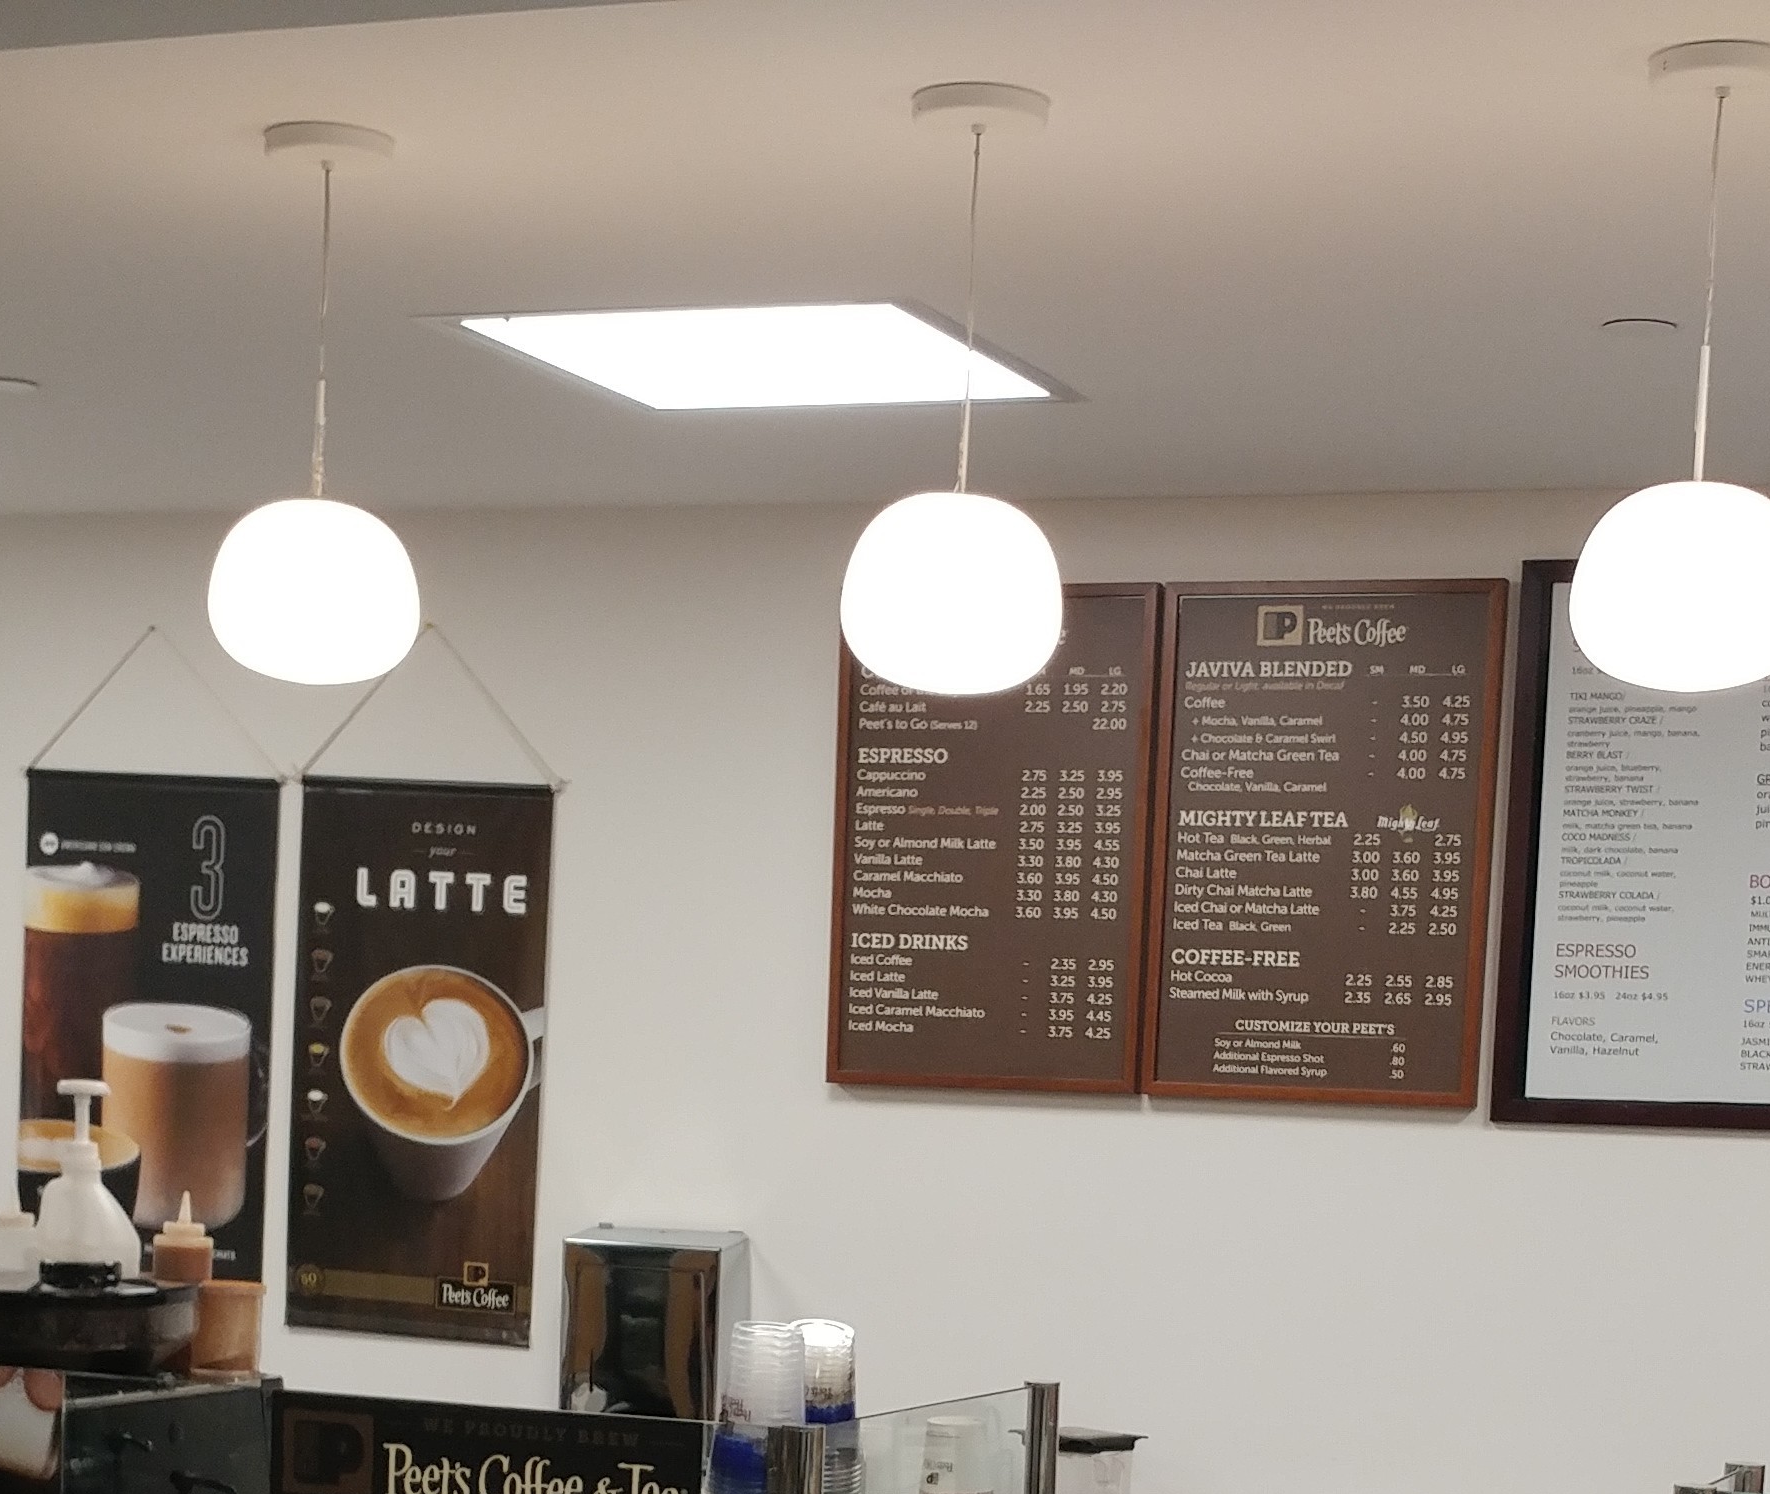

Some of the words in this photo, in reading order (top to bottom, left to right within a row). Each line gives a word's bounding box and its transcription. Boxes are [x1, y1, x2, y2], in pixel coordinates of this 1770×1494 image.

[1354, 618, 1406, 647] Coffee
[1185, 662, 1254, 678] JAVIVA
[1259, 661, 1352, 678] BLENDED
[1568, 717, 1626, 725] STRAWBERRY
[858, 748, 948, 764] ESPRESSO
[857, 770, 926, 782] Cappuccino
[1022, 771, 1046, 781] 2.75
[1060, 771, 1084, 781] 3.25
[1097, 771, 1123, 782] 3.95
[1179, 810, 1257, 827] MIGHTY
[1260, 811, 1309, 828] LEAF
[1311, 812, 1348, 828] TEA
[411, 822, 476, 835] DESIGN
[429, 846, 457, 858] your
[190, 815, 225, 920] 3
[356, 867, 527, 914] LATTE
[1175, 884, 1204, 898] Dirty
[1207, 885, 1234, 897] Chai
[1238, 886, 1280, 898] Matcha
[1283, 886, 1312, 898] Latte
[1350, 887, 1377, 898] 3.80
[1391, 887, 1418, 899] 4.55
[1431, 888, 1458, 899] 4.95
[852, 904, 885, 916] White
[888, 905, 947, 917] Chocolate
[949, 906, 989, 917] Mocha
[1015, 907, 1041, 918] 3.60
[1053, 908, 1078, 919] 3.95
[1090, 909, 1117, 920] 4.50
[173, 922, 238, 944] ESPRESSO
[851, 933, 895, 948] ICED
[899, 935, 968, 950] DRINKS
[162, 943, 249, 967] EXPERIENCES
[1171, 949, 1300, 968] COFFEE-FREE
[1556, 944, 1636, 958] ESPRESSO
[1554, 965, 1649, 979] SMOOTHIES
[1235, 1020, 1310, 1033] CUSTOMIZE
[1313, 1022, 1349, 1034] YOUR
[1353, 1023, 1395, 1035] PEET'S
[1551, 1032, 1606, 1043] Chocolate,
[1611, 1033, 1658, 1044] Caramel,
[473, 1287, 510, 1310] Coffee
